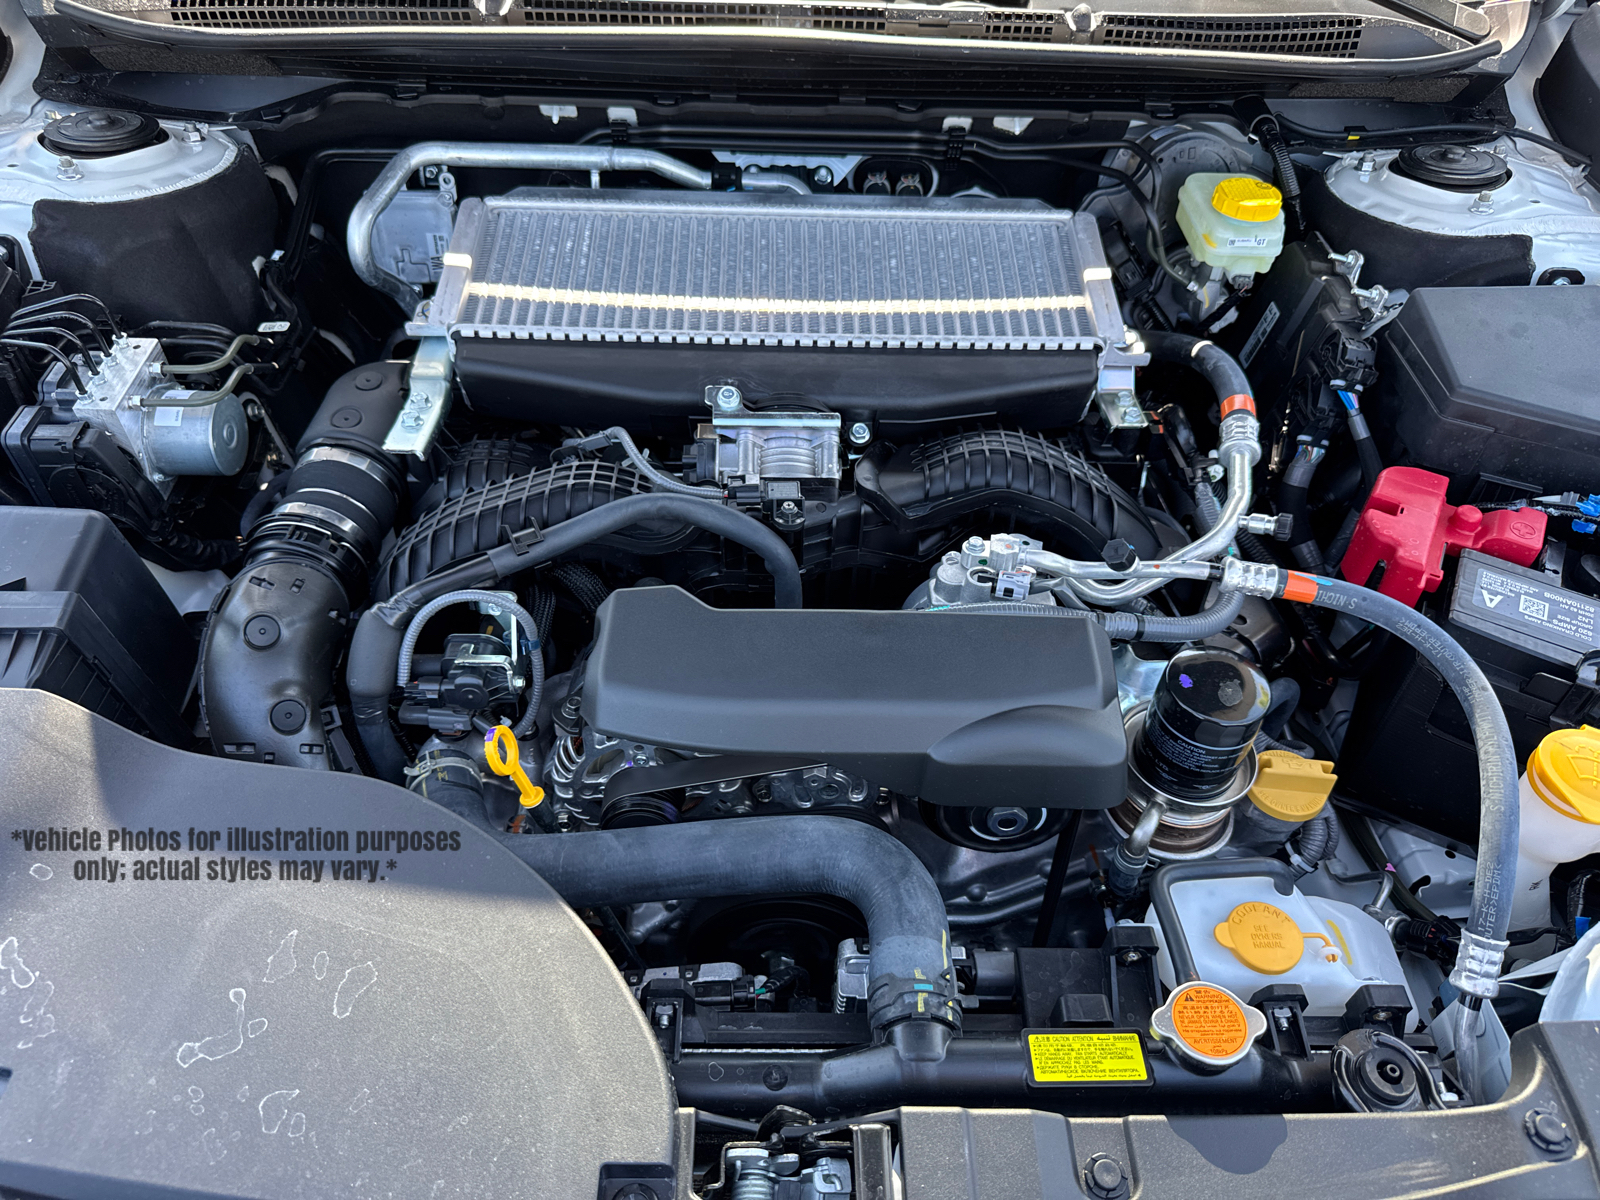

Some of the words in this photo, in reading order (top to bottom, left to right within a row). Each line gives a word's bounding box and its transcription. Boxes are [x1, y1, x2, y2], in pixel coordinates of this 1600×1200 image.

[1316, 590, 1357, 609] S·NICHI
[1544, 591, 1595, 613] 82110AN00B
[1524, 615, 1542, 624] AMPS
[1557, 614, 1571, 622] SIZE
[1578, 615, 1594, 625] LN2
[1542, 622, 1574, 635] CRANKING
[1552, 619, 1576, 631] AMPS
[1571, 620, 1593, 630] GROUP
[1575, 632, 1592, 641] COLD
[1578, 628, 1593, 636] 620
[1177, 739, 1206, 754] CAUTION
[1231, 904, 1291, 925] COOLANT
[1252, 941, 1286, 949] MANUAL
